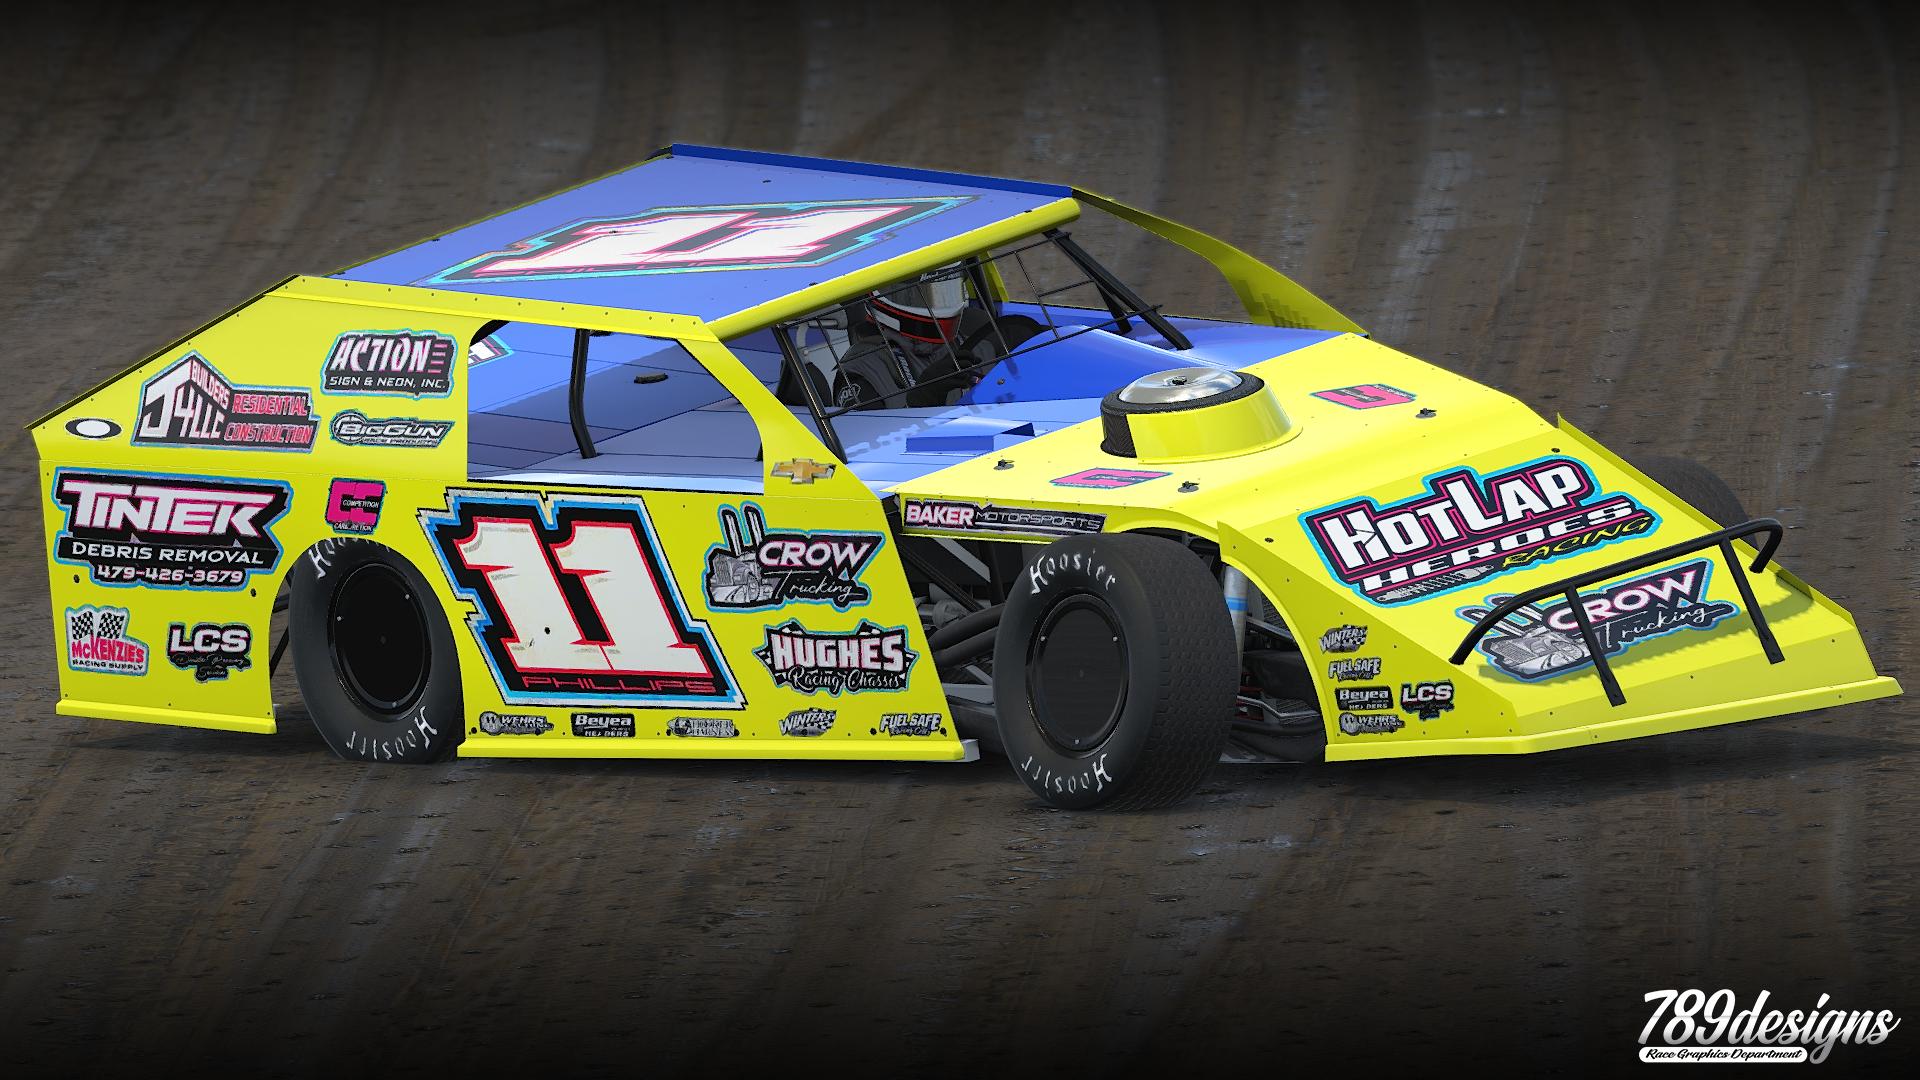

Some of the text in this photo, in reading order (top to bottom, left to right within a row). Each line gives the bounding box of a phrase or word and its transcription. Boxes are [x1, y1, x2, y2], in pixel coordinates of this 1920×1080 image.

[472, 206, 912, 273] 11
[329, 336, 432, 373] ACTION
[191, 360, 231, 411] BUILDERS
[329, 376, 447, 389] SIGN & NEON, INC.
[232, 393, 308, 416] RESIDENTIAL
[223, 421, 313, 444] CONSTRUCTION
[906, 505, 1101, 531] BAKER MOTORSPORTS
[72, 542, 264, 565] DEBRIS REMOVAL
[758, 542, 872, 567] CROW
[1361, 501, 1633, 591] HEROES
[1502, 516, 1652, 568] RACING
[97, 564, 244, 584] 479-426-3679
[764, 568, 856, 602] Trucking
[1030, 549, 1116, 595] Hoosier
[453, 516, 713, 677] 11
[1548, 569, 1698, 631] CROW
[170, 629, 249, 653] LCS
[771, 633, 904, 672] HUGHES
[1319, 628, 1368, 654] WINTERS
[72, 658, 144, 671] RACING SUPPLY
[1328, 659, 1353, 679] FUEL
[1354, 658, 1381, 674] SAFE
[522, 676, 717, 693] PHILLIPS
[788, 665, 899, 691] Racing Chassis
[1339, 690, 1389, 702] Beyea
[1402, 684, 1453, 703] LCS
[346, 706, 438, 760] Hoosier
[575, 714, 632, 729] Beyea
[779, 710, 837, 736] WINTERS
[880, 713, 941, 733] FUEL SAFE
[1021, 753, 1112, 793] Hoosier
